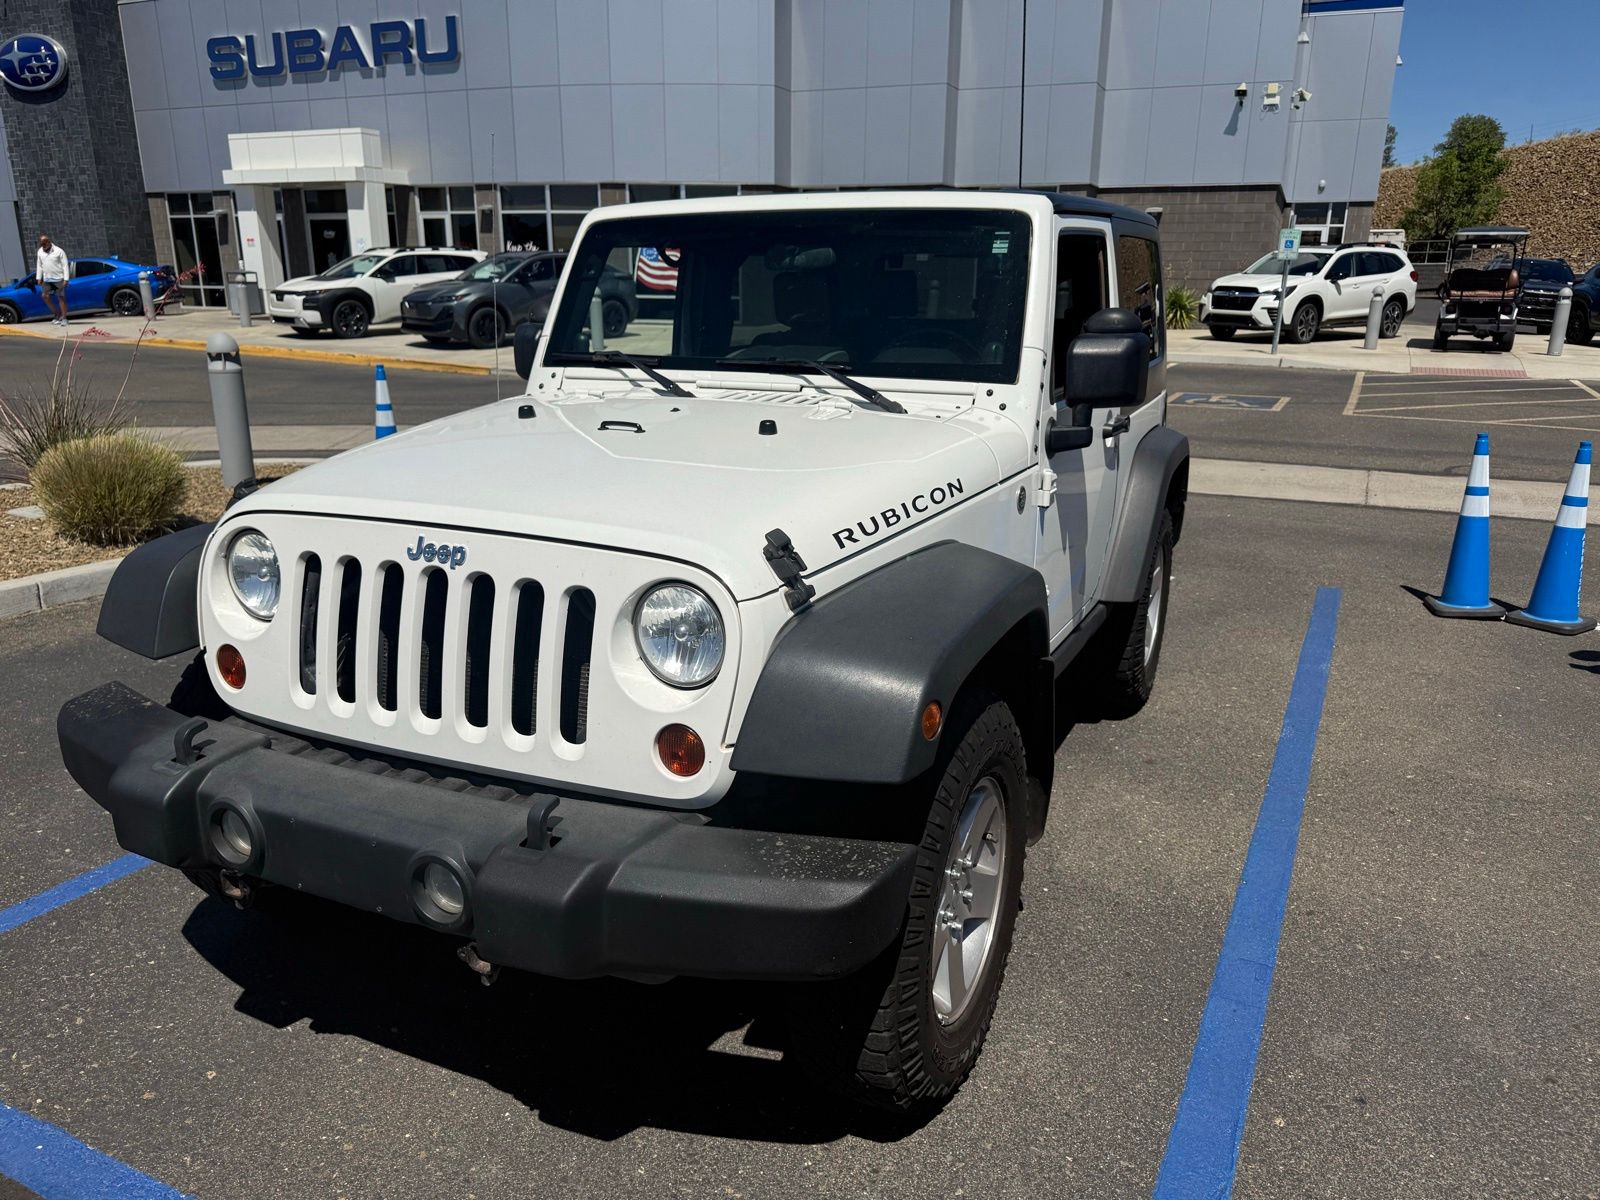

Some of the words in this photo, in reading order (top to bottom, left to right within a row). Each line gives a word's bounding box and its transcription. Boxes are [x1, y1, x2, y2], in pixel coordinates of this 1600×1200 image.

[206, 16, 458, 80] SUBARU
[832, 478, 964, 550] RUBICON
[407, 535, 466, 570] Jeep
